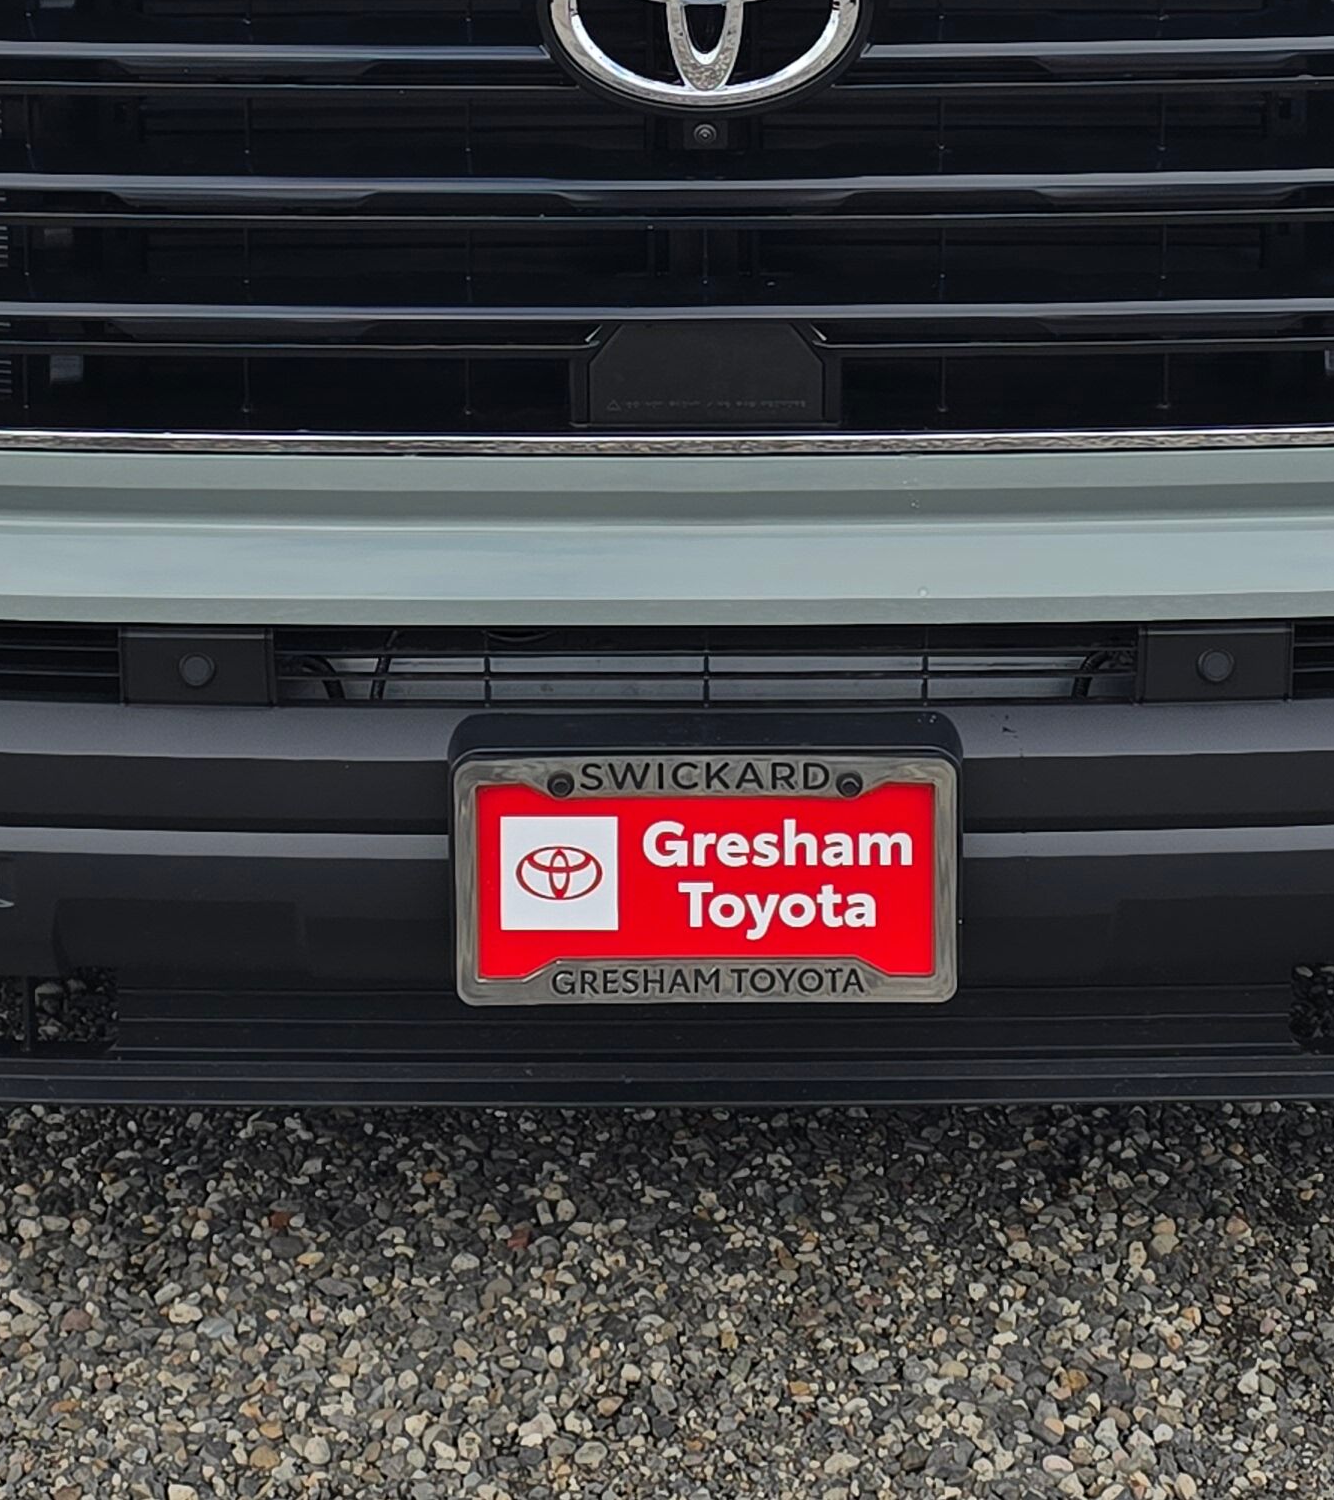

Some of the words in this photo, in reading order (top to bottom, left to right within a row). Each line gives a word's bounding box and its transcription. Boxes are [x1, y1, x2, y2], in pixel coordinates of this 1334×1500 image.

[579, 761, 831, 792] SWICKARD
[641, 818, 914, 868] Gresham
[677, 881, 877, 941] Toyota
[551, 967, 721, 995] GRESHAM
[730, 967, 866, 994] TOYOTA
